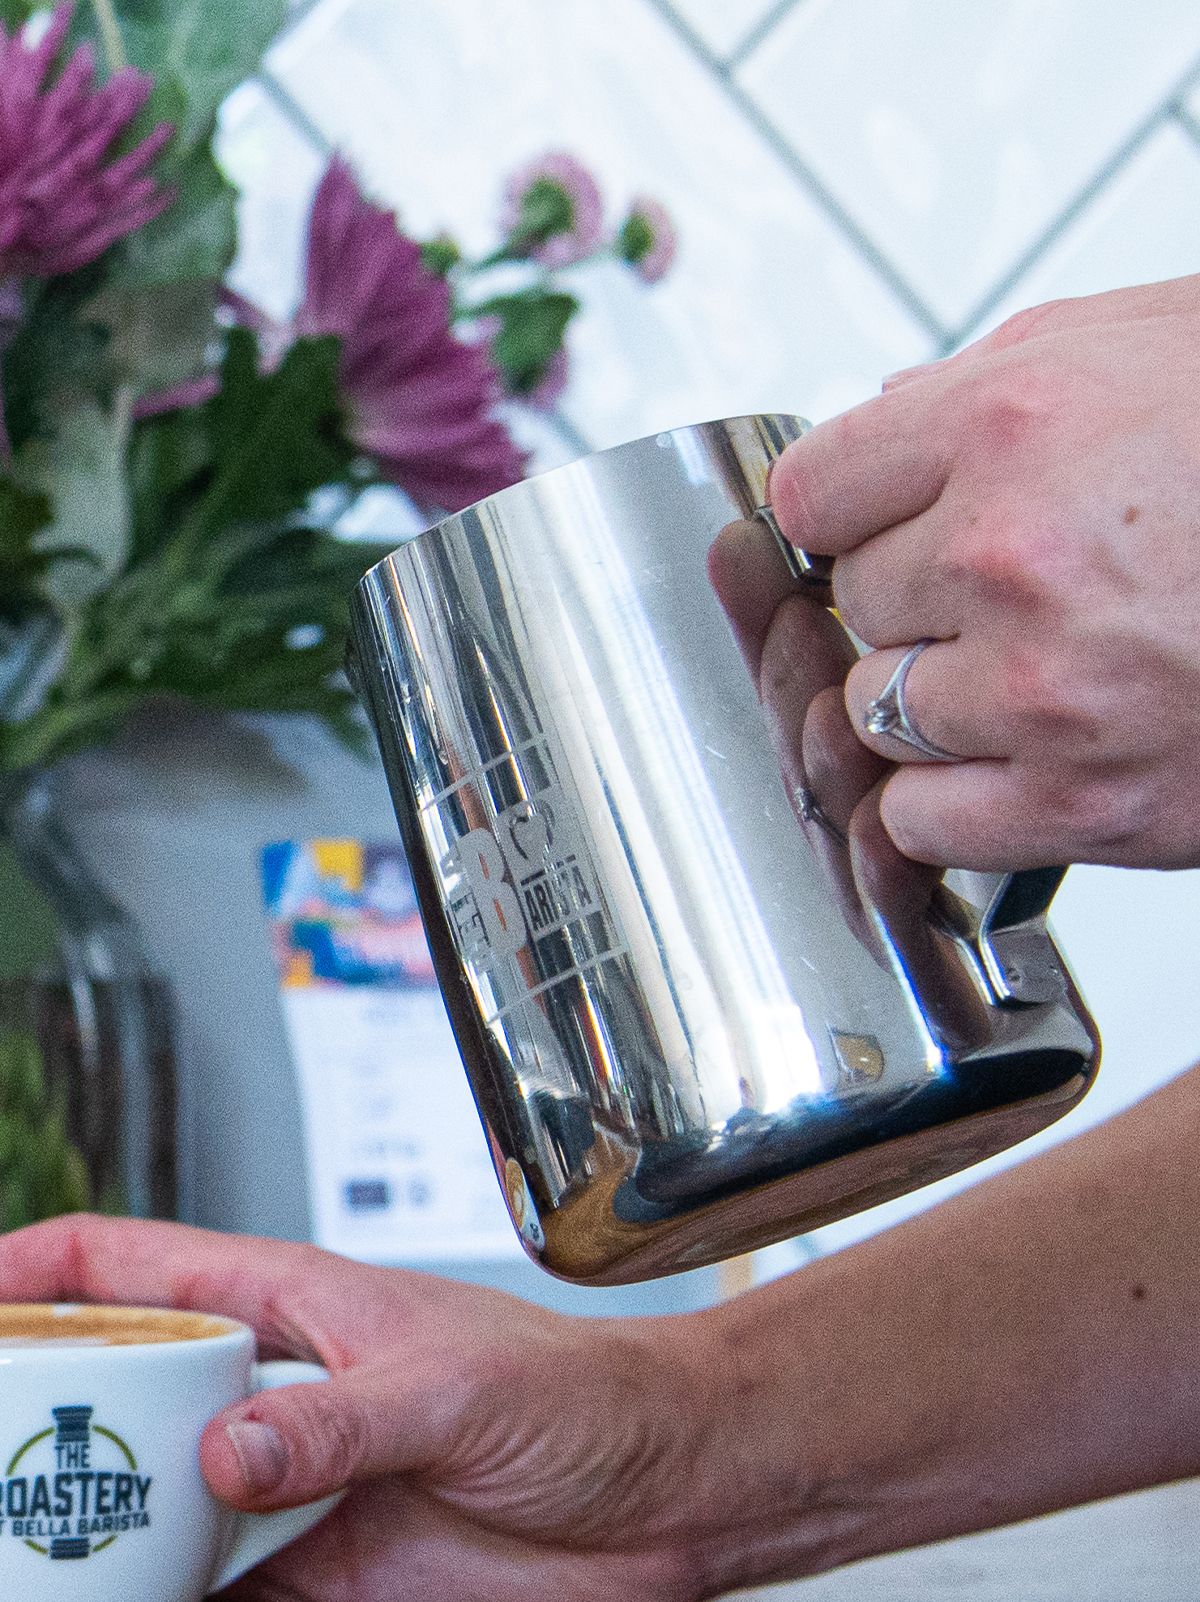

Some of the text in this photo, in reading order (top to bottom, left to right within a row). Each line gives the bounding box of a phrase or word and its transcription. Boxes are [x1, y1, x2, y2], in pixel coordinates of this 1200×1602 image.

[55, 1444, 90, 1469] THE
[12, 1519, 70, 1536] BELLA
[77, 1511, 150, 1535] BARISTA
